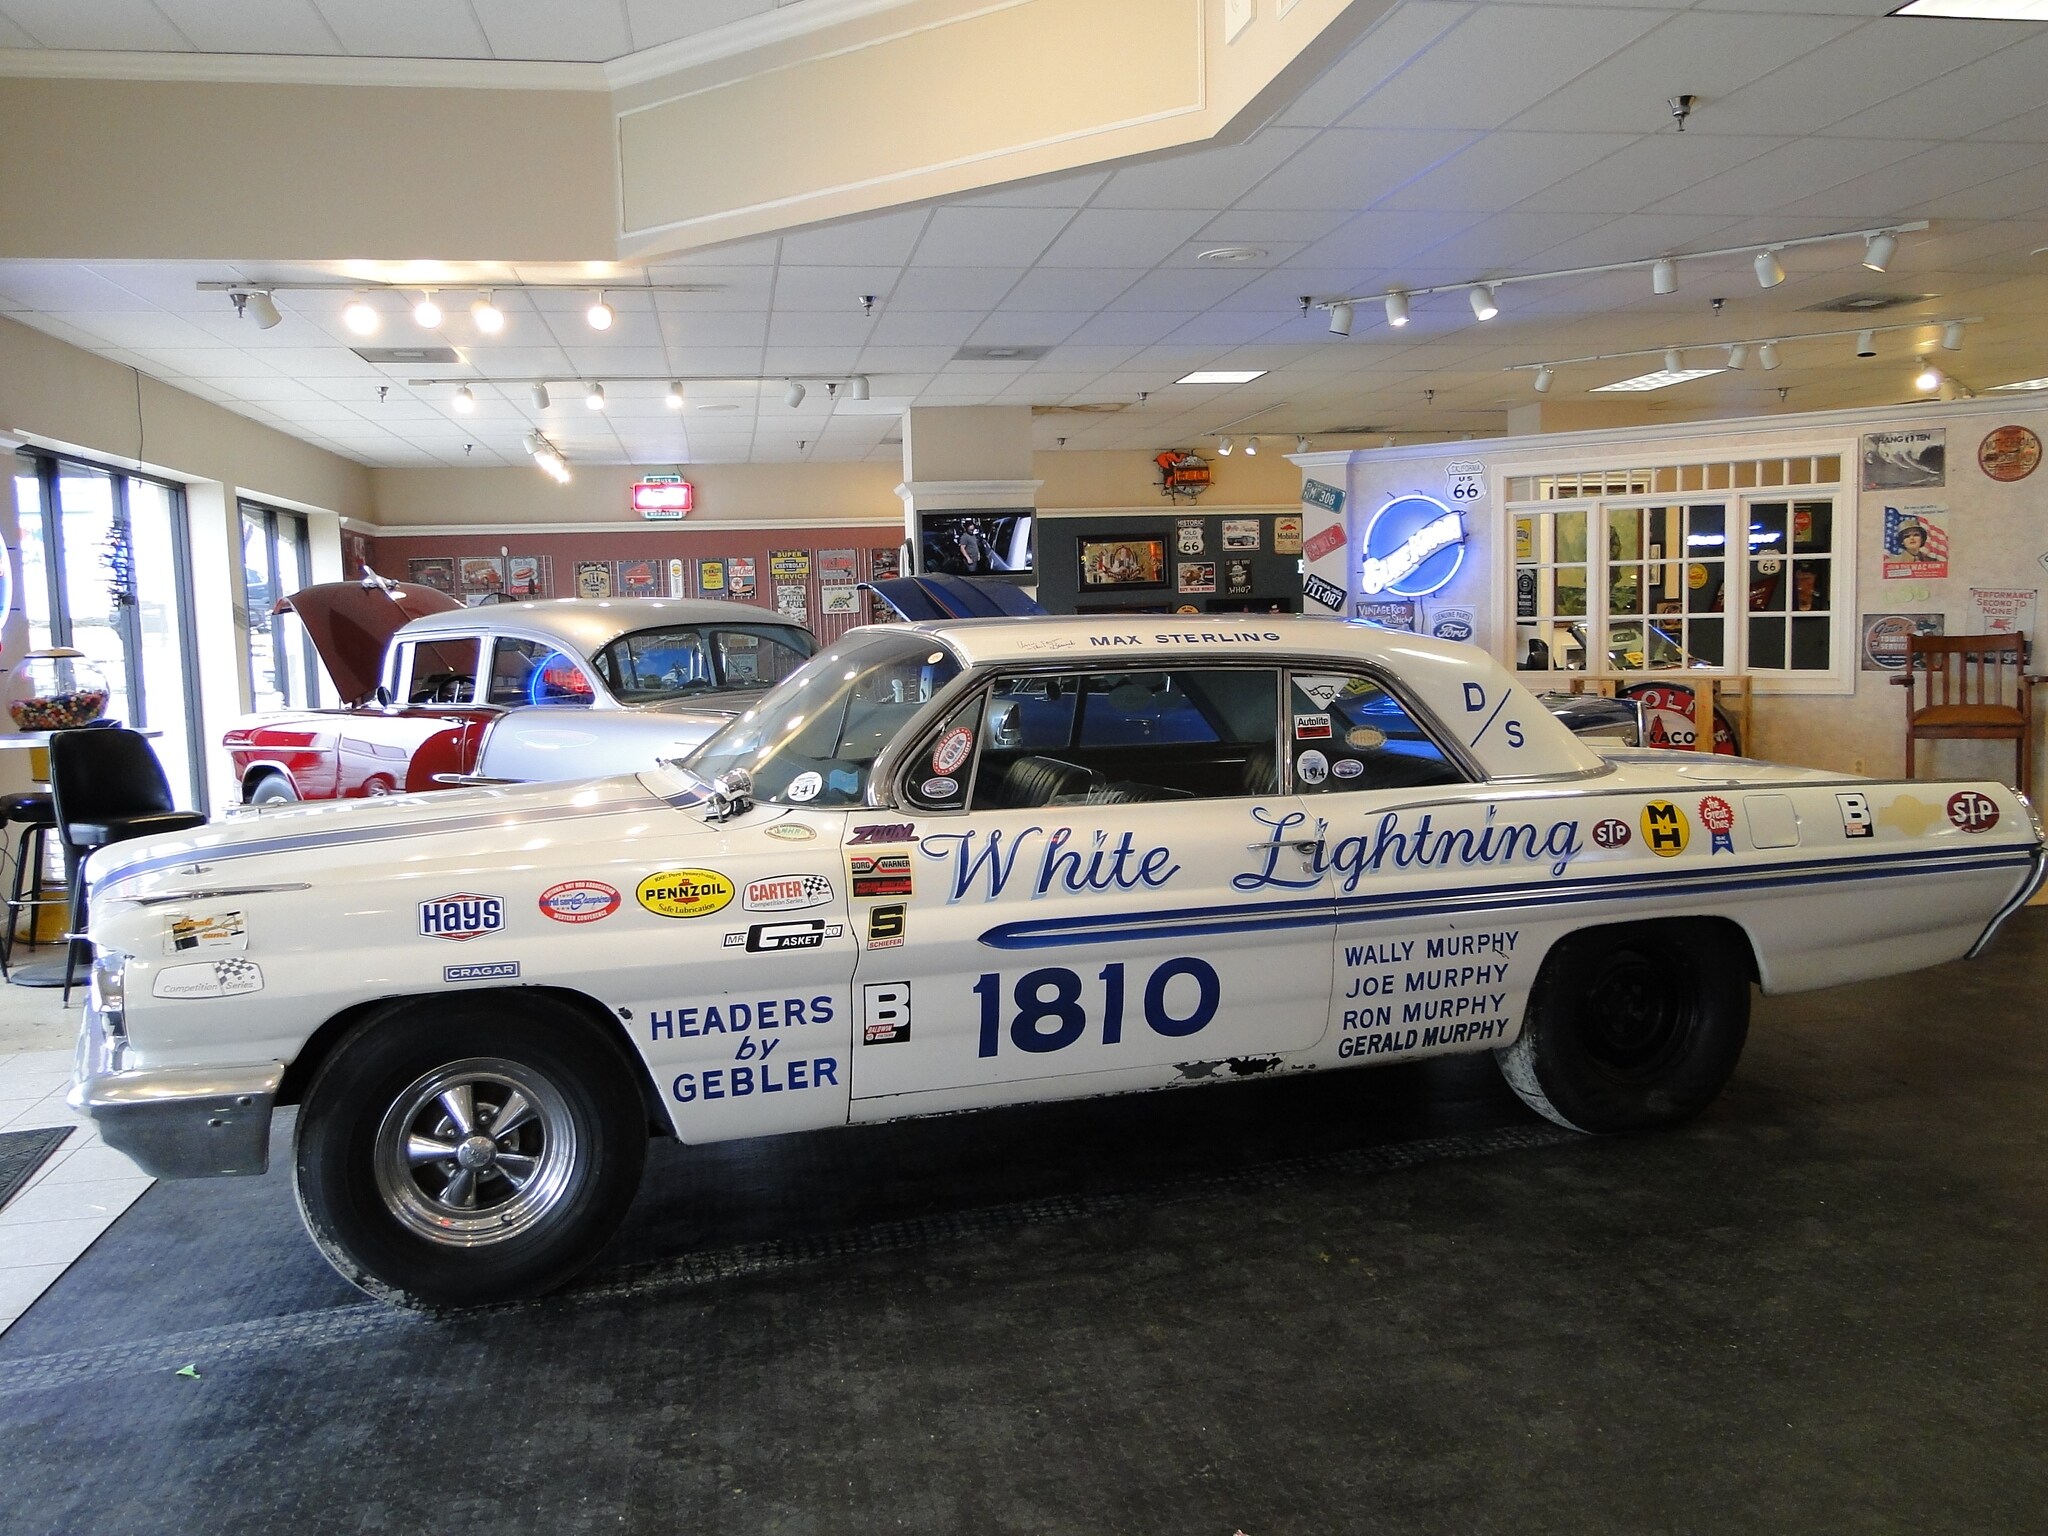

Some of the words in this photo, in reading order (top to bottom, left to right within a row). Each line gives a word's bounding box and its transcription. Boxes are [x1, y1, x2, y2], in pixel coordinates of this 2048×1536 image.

[1916, 433, 1931, 442] TEN
[1318, 490, 1336, 506] 308
[1453, 483, 1479, 499] 66
[1177, 519, 1204, 527] HISTORIC
[1183, 541, 1200, 552] 66
[774, 561, 807, 569] CHEVROLET
[1762, 563, 1777, 571] 66
[1228, 585, 1251, 594] WHO?
[1972, 589, 2034, 600] PERFORMANCE
[1357, 604, 1391, 616] VINTAGE
[1390, 603, 1407, 615] ROD
[1976, 598, 2012, 607] SECOND
[2015, 599, 2027, 607] TO
[1434, 611, 1455, 621] GENUINE
[1436, 622, 1470, 638] Ford
[1089, 634, 1143, 647] MAX
[1155, 632, 1281, 645] STERLING
[1297, 717, 1329, 727] Autolite
[949, 741, 971, 772] REUNION
[1302, 766, 1326, 780] 194
[791, 784, 816, 797] 241
[1647, 804, 1678, 824] M
[1704, 806, 1729, 820] Great
[1953, 794, 1993, 826] STP
[1710, 818, 1730, 830] Ones
[1596, 820, 1627, 843] STP
[1652, 827, 1681, 848] H
[920, 826, 1182, 902] White
[1232, 804, 1584, 892] Lightning
[851, 861, 871, 870] BORG
[881, 859, 911, 868] WARNER
[682, 871, 717, 880] Pennsylvania
[575, 881, 586, 889] ROD
[645, 883, 727, 901] PENNZOIL
[749, 880, 803, 902] CARTER
[658, 902, 674, 913] Safe
[675, 902, 716, 914] Lubrication
[750, 899, 785, 908] Competition
[423, 900, 501, 933] Hays
[577, 909, 608, 921] CONFERENCE
[868, 937, 902, 949] SCHIEFER
[1344, 940, 1415, 967] WALLY
[1427, 930, 1520, 960] MURPHY
[449, 965, 515, 978] CRAGAR
[163, 982, 218, 993] Competition
[225, 980, 254, 990] Series
[1345, 974, 1395, 998] JOE
[1405, 963, 1509, 993] MURPHY
[972, 956, 1221, 1059] 1810
[1342, 1005, 1391, 1031] RON
[1402, 992, 1506, 1024] MURPHY
[650, 995, 834, 1041] HEADERS
[1338, 1028, 1418, 1059] GERALD
[1421, 1017, 1510, 1048] MURPHY
[734, 1035, 780, 1061] by
[672, 1057, 839, 1103] GEBLER
